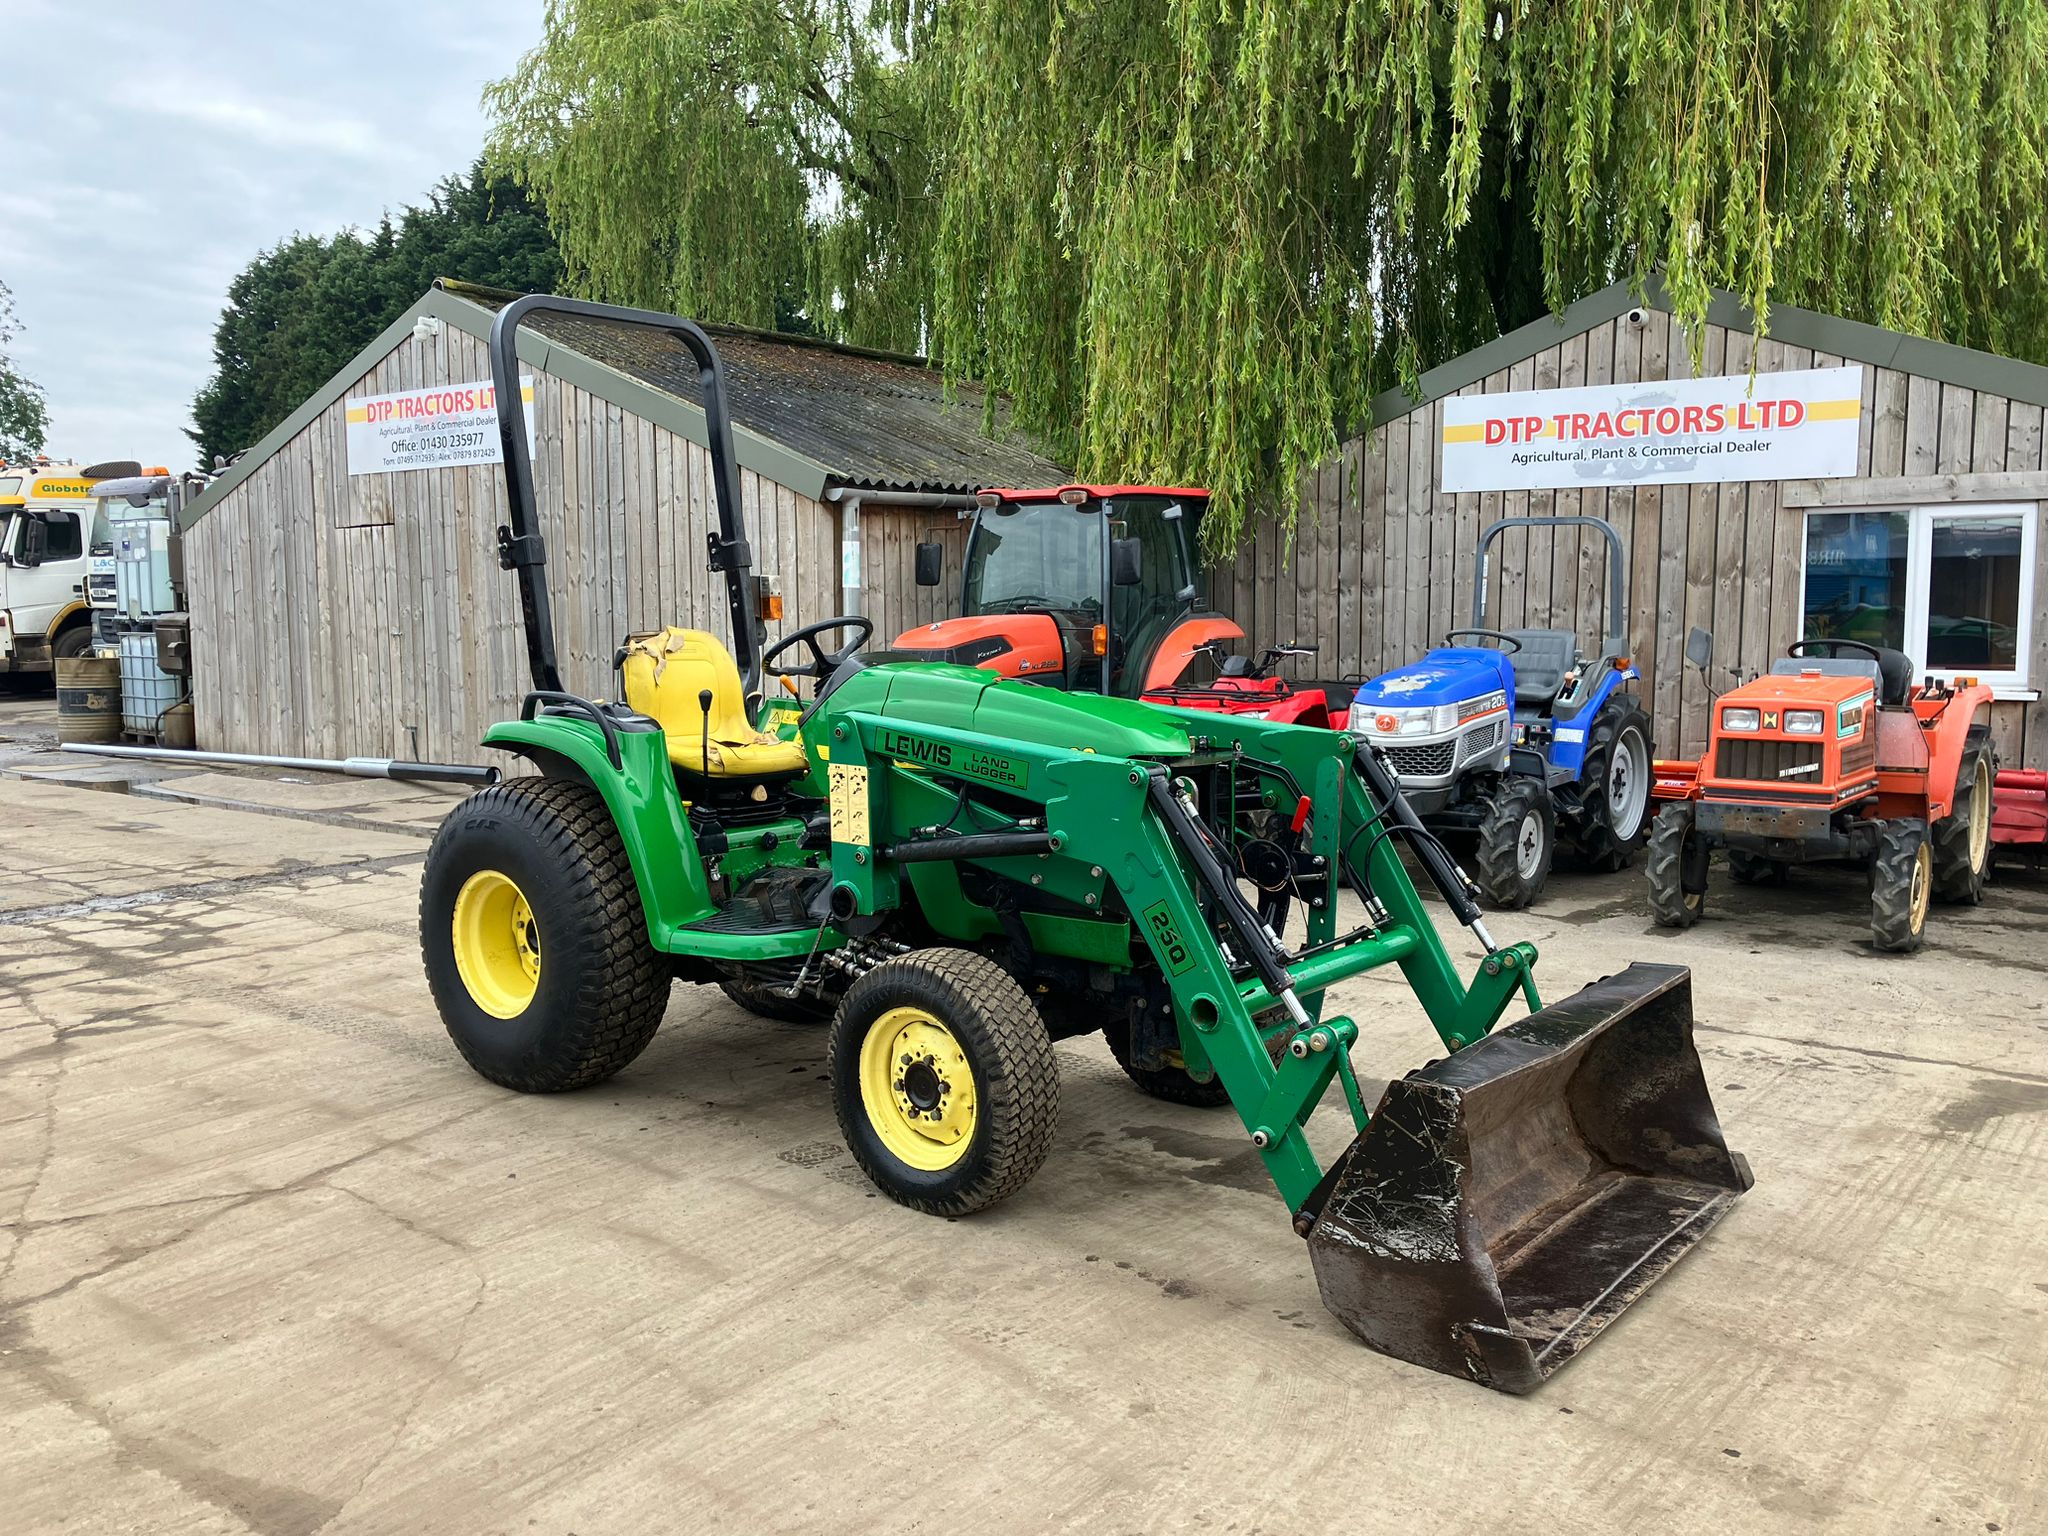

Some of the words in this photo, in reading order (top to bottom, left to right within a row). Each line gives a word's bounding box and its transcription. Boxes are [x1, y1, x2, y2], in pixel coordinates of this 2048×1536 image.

[367, 401, 393, 423] DTP
[396, 389, 475, 419] TRACTORS
[480, 386, 497, 410] LT
[415, 422, 430, 432] Plant
[431, 421, 437, 431] &
[437, 417, 475, 430] Commercial
[476, 416, 497, 426] Dealer
[1485, 416, 1544, 445] DTP
[1553, 403, 1726, 441] TRACTORS
[1738, 399, 1805, 430] LTD
[391, 439, 419, 454] Office:
[420, 435, 448, 451] 01430
[450, 432, 484, 448] 235977
[1511, 448, 1588, 466] Agricultural,
[1591, 447, 1625, 460] Plant
[1628, 446, 1638, 458] &
[1642, 441, 1723, 457] Commercial
[1726, 439, 1773, 453] Dealer
[42, 484, 91, 493] Globetr
[884, 732, 953, 767] LEWIS
[963, 762, 1017, 783] LUGGER
[972, 753, 1010, 770] LAND
